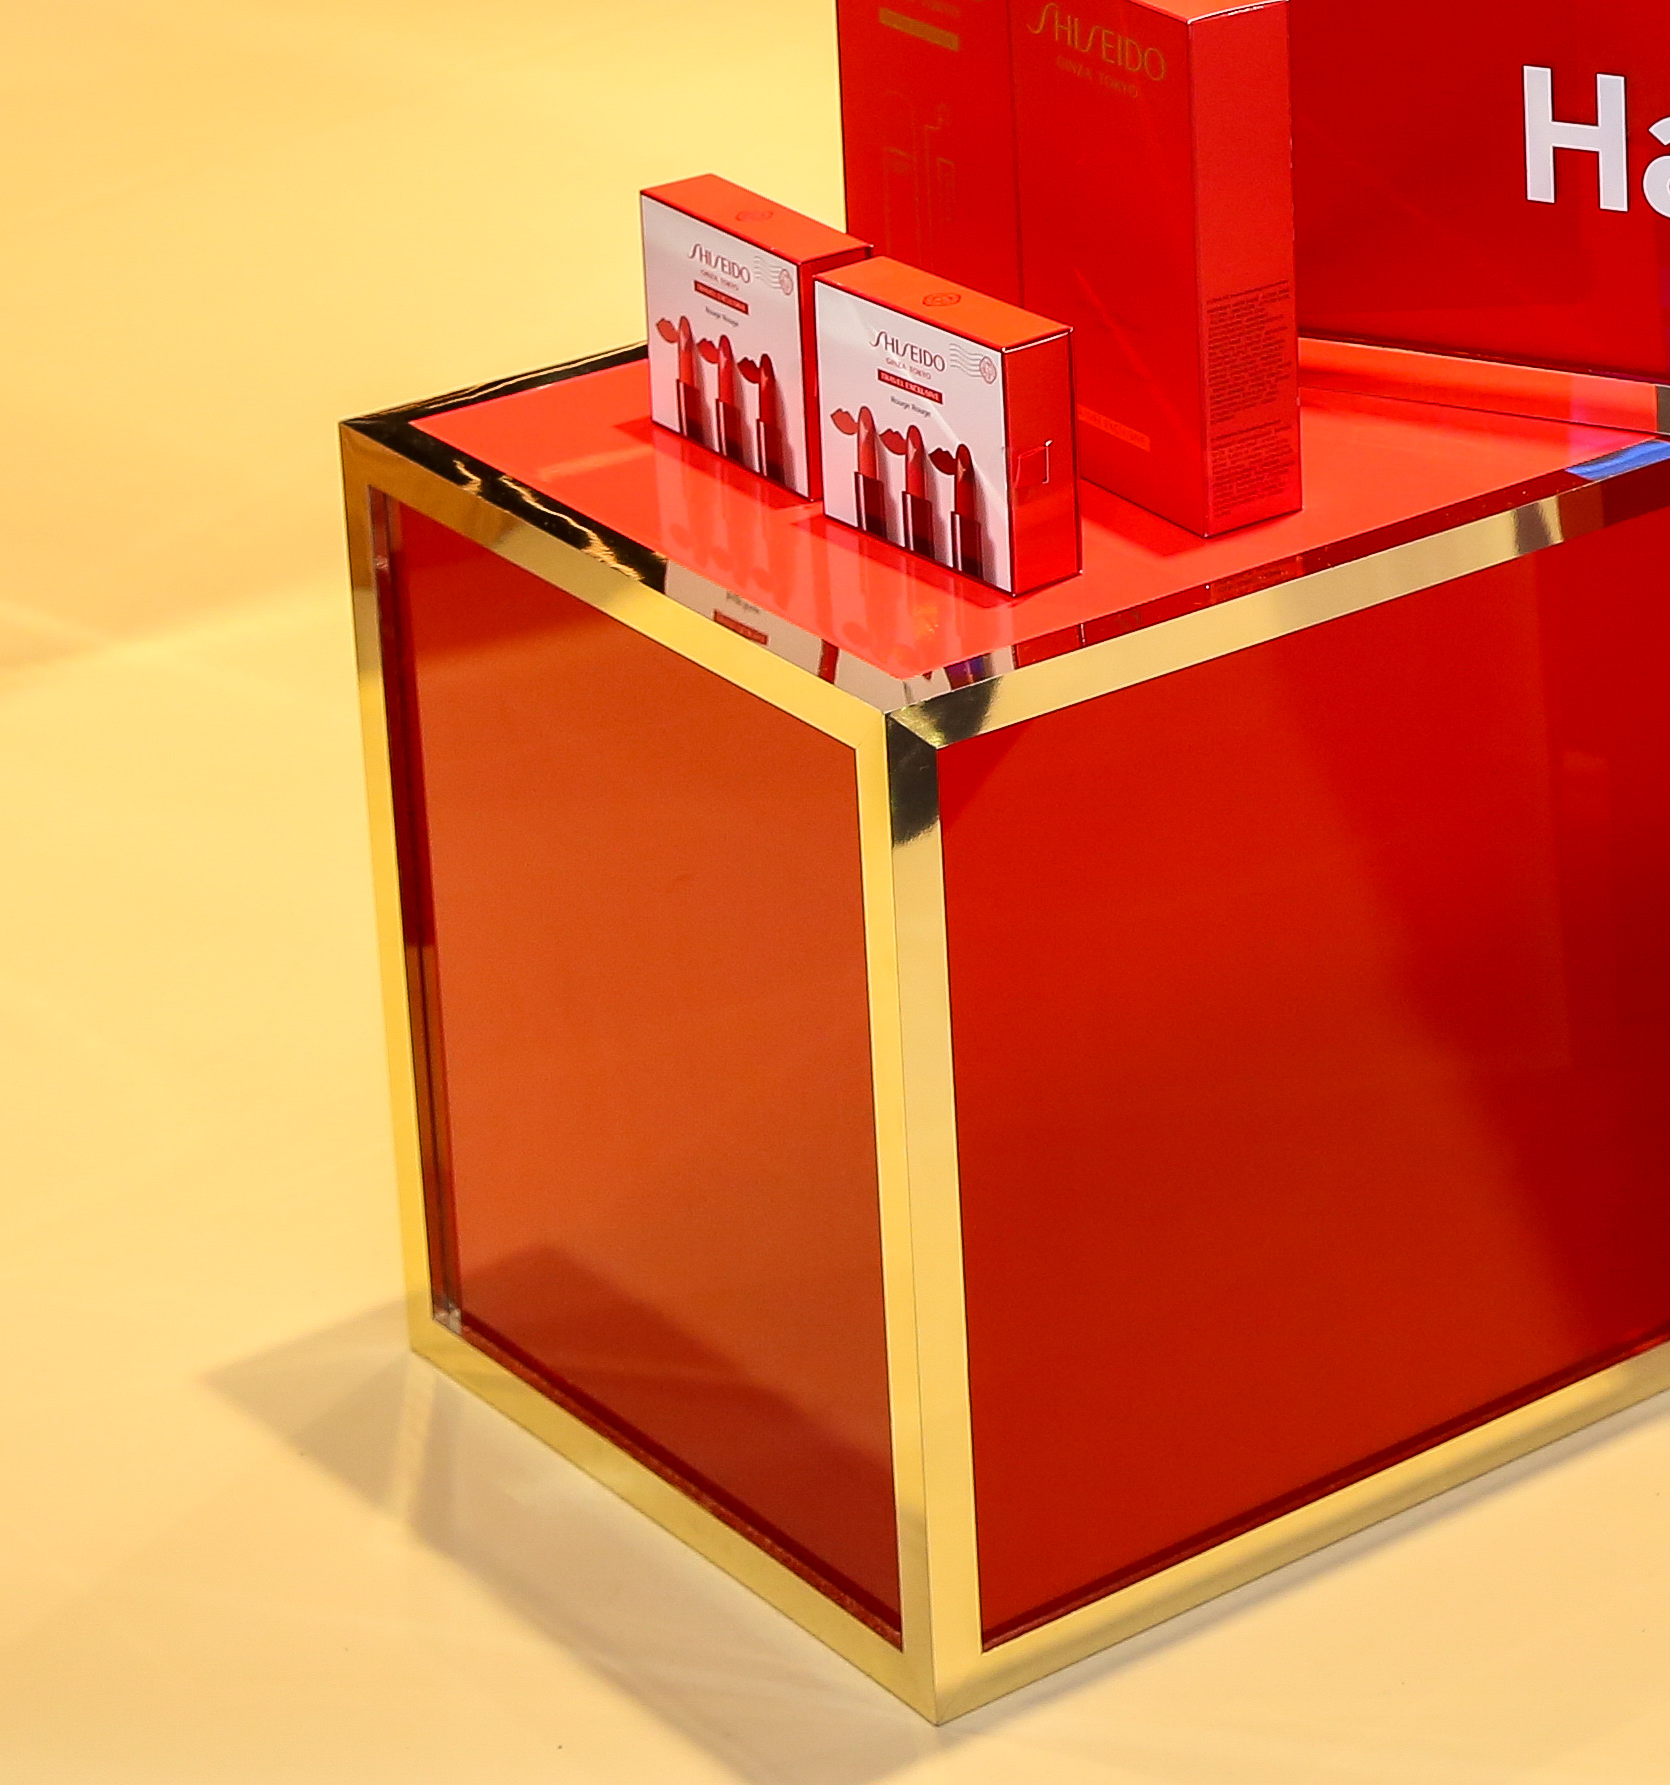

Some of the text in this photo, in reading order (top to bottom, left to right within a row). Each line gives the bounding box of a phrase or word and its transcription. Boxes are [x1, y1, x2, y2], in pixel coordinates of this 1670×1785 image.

[1026, 2, 1166, 81] SHISEIDO
[688, 243, 751, 284] SHISEIDO
[868, 331, 945, 372] SHISEIDO
